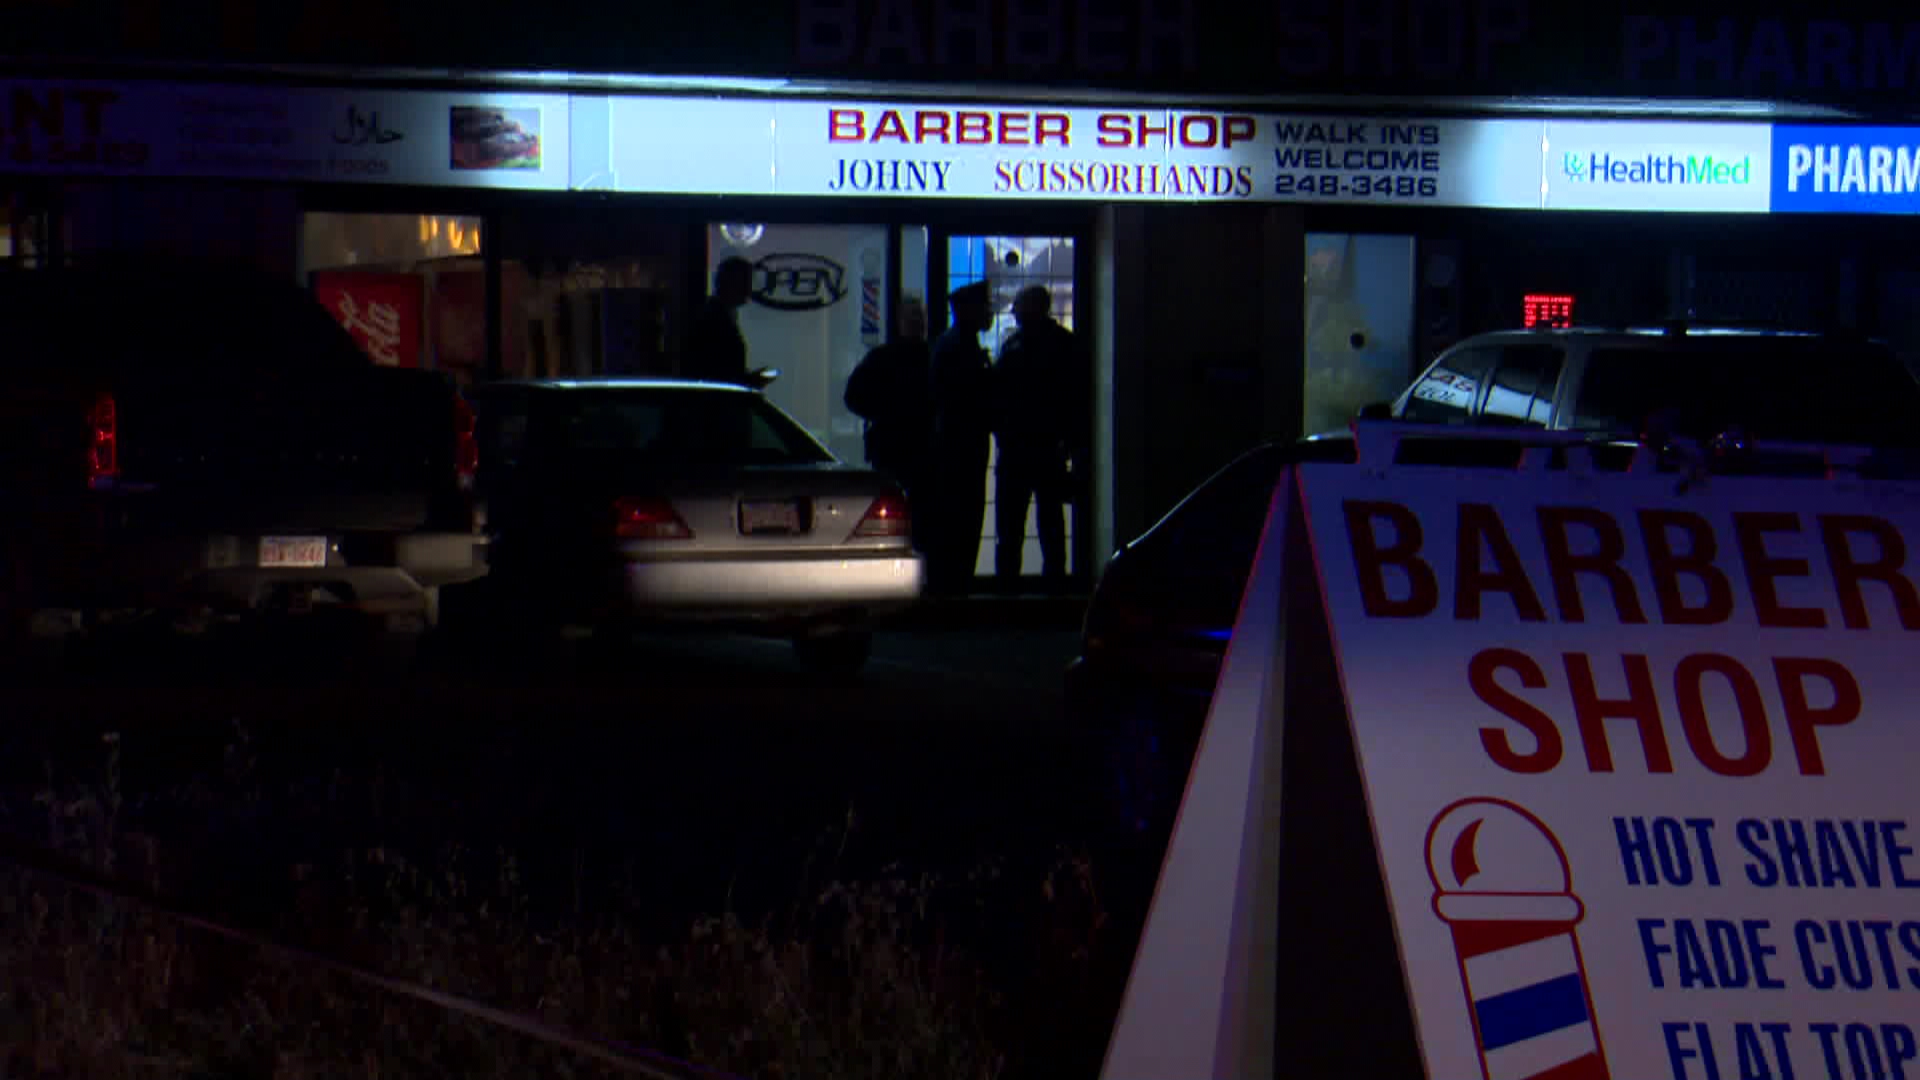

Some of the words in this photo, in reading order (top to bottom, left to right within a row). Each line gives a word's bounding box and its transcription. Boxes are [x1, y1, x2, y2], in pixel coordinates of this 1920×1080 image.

[795, 0, 1196, 76] BARBER
[829, 109, 1072, 146] BARBER
[1097, 114, 1257, 149] SHOP
[1274, 120, 1367, 144] WALK
[1380, 121, 1440, 145] IN'S
[829, 159, 951, 191] JOHNY
[994, 160, 1252, 197] SCISSORHANDS
[1274, 147, 1440, 171] WELCOME
[1590, 152, 1752, 184] HealthMed
[1274, 174, 1438, 197] 248-3486
[1341, 499, 1920, 631] BARBER
[1467, 646, 1863, 778] SHOP
[1612, 816, 1722, 886] HOT
[1735, 819, 1920, 888] SHAVE
[1636, 918, 1786, 989] FADE
